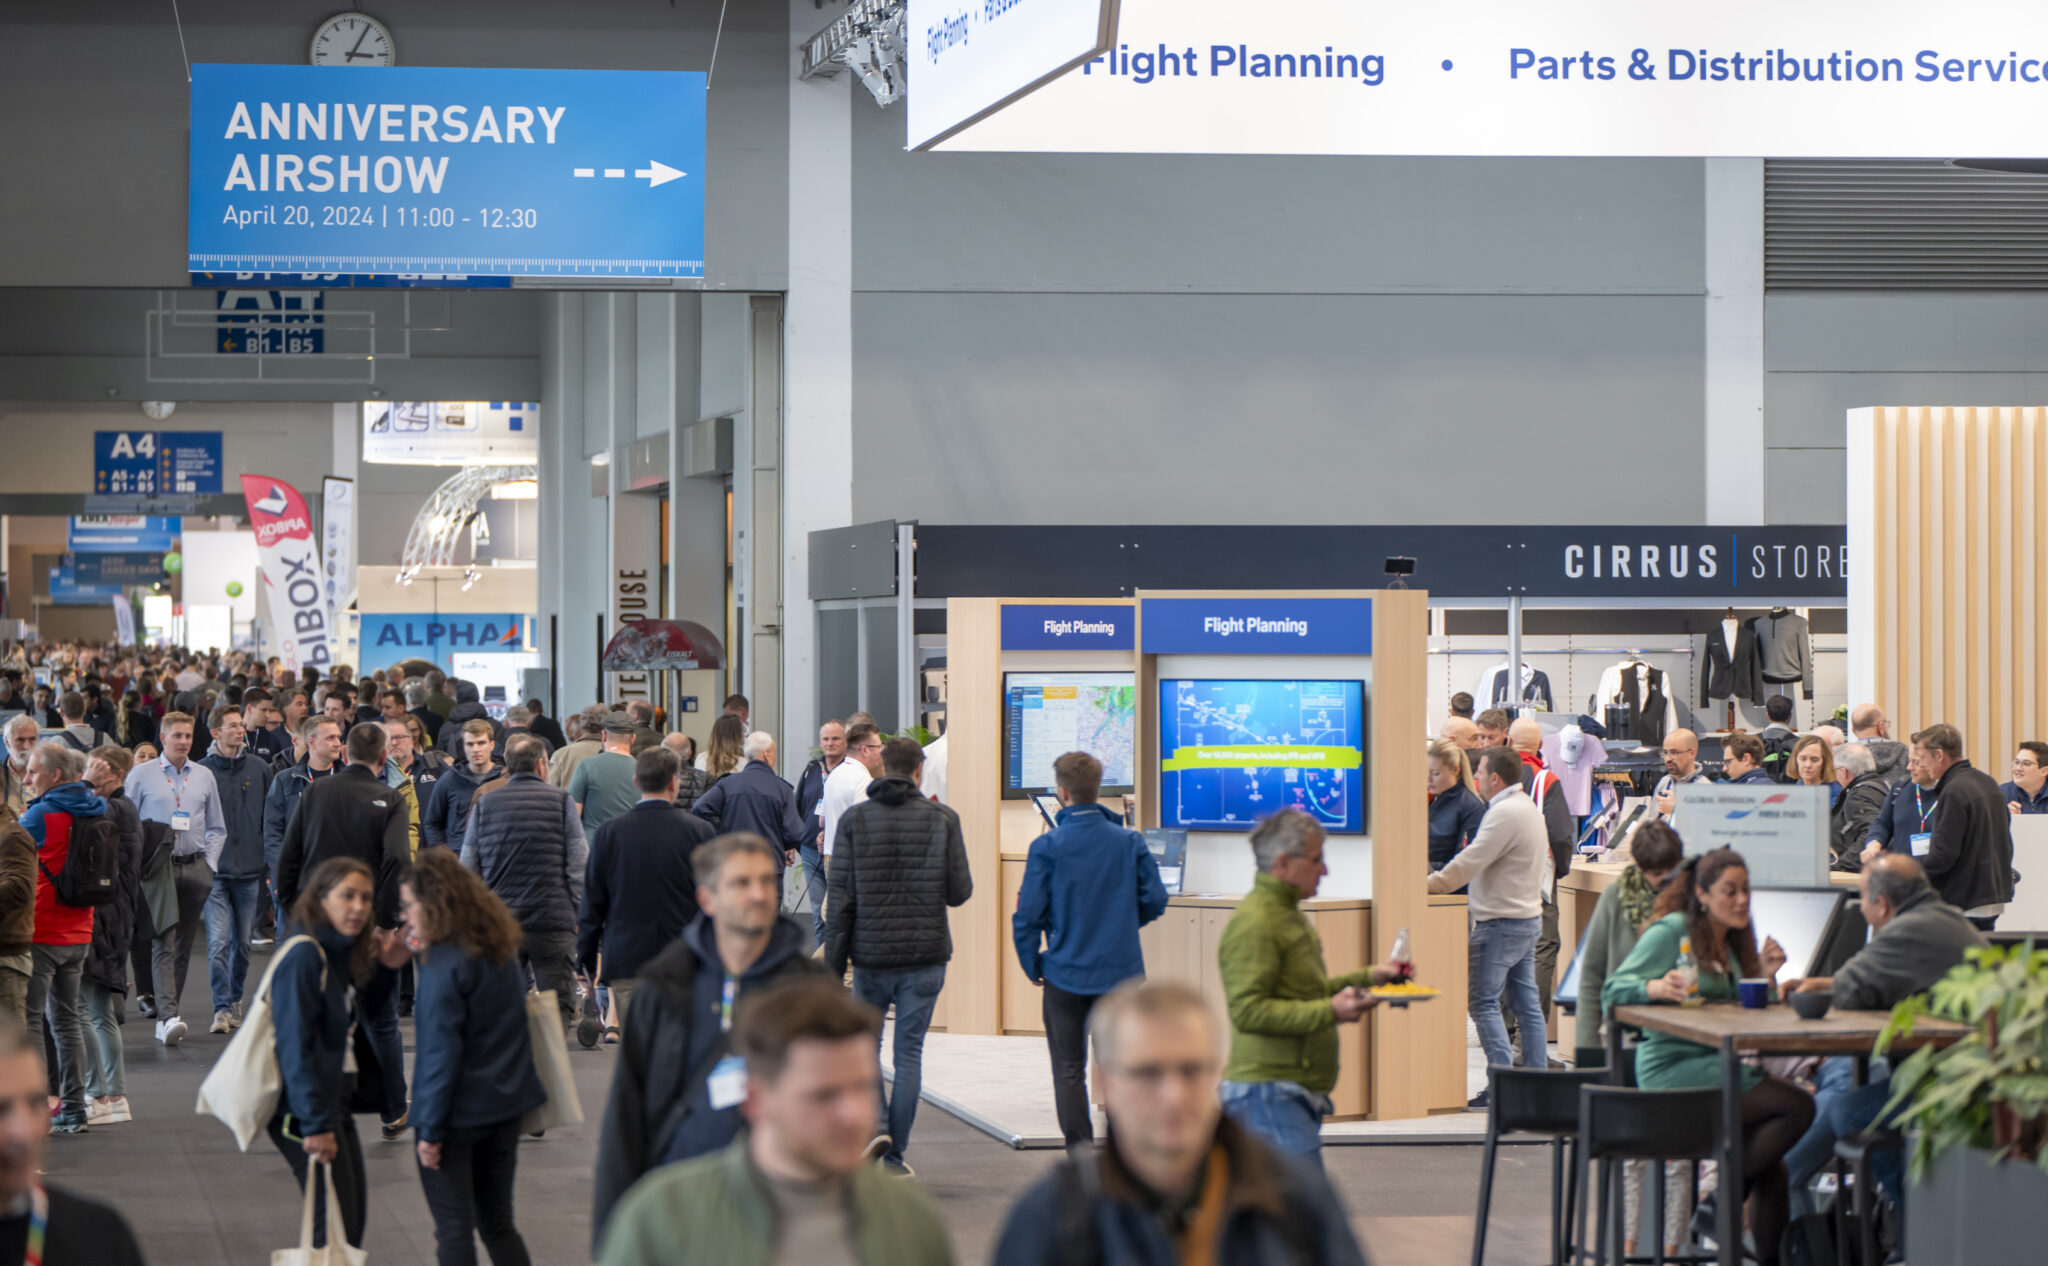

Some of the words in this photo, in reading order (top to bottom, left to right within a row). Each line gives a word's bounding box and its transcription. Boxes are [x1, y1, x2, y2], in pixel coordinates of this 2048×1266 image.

[1210, 44, 1385, 87] Planning
[1510, 48, 1616, 80] Parts
[1627, 48, 1657, 81] &
[1669, 49, 1903, 82] Distribution
[223, 101, 566, 144] ANNIVERSARY
[223, 153, 449, 194] AIRSHOW
[222, 204, 277, 230] April
[283, 205, 315, 228] 20,
[323, 206, 374, 226] 2024
[397, 207, 454, 228] 11:00
[480, 208, 537, 229] 12:30
[246, 338, 270, 353] B1
[289, 338, 314, 353] B5
[110, 433, 156, 459] A4
[1564, 545, 1717, 578] CIRRUS
[1752, 545, 1847, 578] STORE
[376, 623, 500, 646] ALPHA
[1044, 619, 1072, 636] Flight
[1073, 619, 1115, 636] Planning
[1204, 616, 1244, 636] Flight
[1247, 616, 1308, 636] Planning
